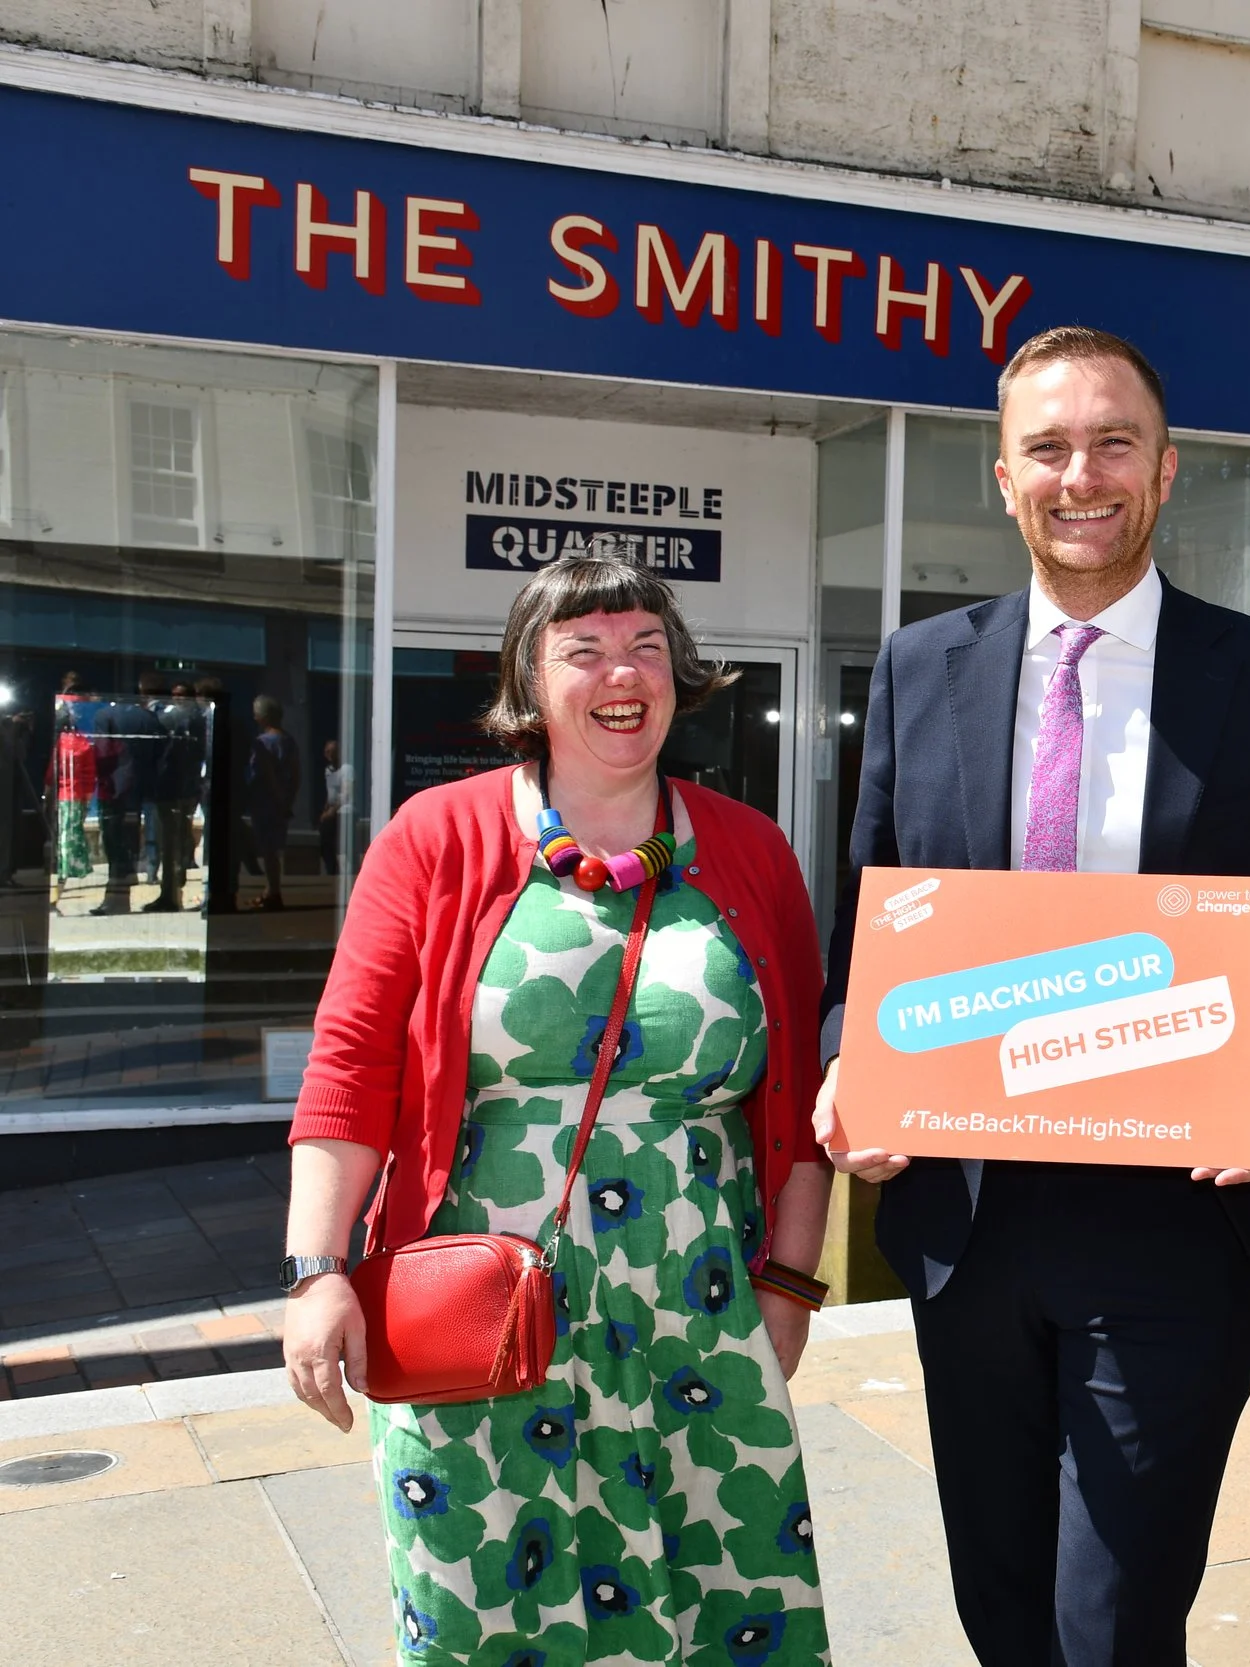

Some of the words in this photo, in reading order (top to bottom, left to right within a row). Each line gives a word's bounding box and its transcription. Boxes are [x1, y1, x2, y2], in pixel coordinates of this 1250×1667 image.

[188, 166, 480, 304] THE
[547, 214, 1032, 364] SMITHY
[466, 470, 722, 520] MIDSTEEPLE
[491, 525, 696, 570] QUARTER
[873, 913, 893, 928] THE
[892, 901, 917, 919] HIGH
[1196, 900, 1250, 916] change
[1197, 890, 1241, 902] power
[897, 907, 929, 928] STREET
[897, 1003, 942, 1031] I'M
[949, 971, 1087, 1020] BACKING
[1094, 953, 1163, 987] OUR
[1008, 1033, 1087, 1069] HIGH
[1096, 1002, 1227, 1050] STREETS
[900, 1109, 1192, 1142] #TakeBackTheHighStreet
